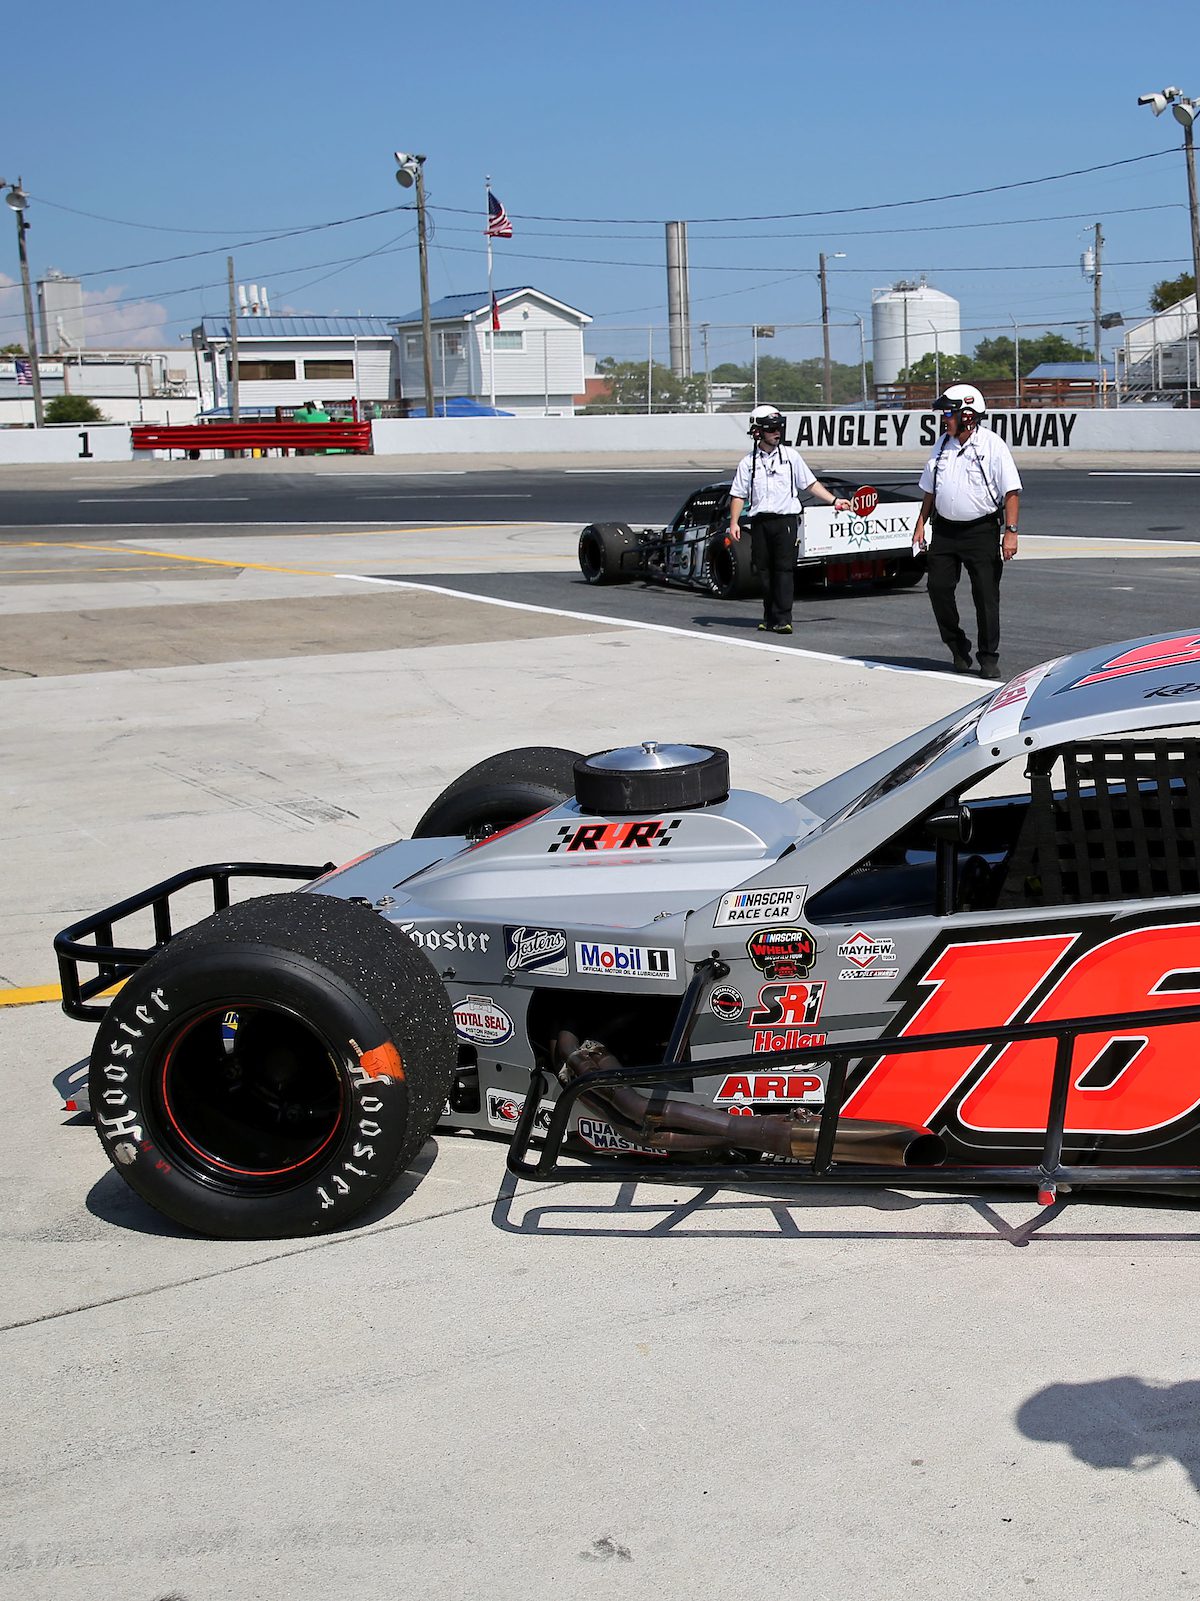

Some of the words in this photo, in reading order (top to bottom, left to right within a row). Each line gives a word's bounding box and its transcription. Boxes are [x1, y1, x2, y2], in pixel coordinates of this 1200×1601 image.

[780, 414, 909, 446] LANGLEY
[920, 413, 1076, 446] SDWAY
[78, 432, 93, 458] 1
[853, 492, 878, 511] STOP
[829, 516, 911, 539] PHOENIX
[567, 820, 664, 852] RYR
[746, 891, 794, 907] NASCAR
[728, 909, 761, 920] RACE
[764, 907, 789, 918] CAR
[507, 927, 566, 970] Jostens
[769, 932, 803, 943] NASCAR
[581, 944, 641, 970] Mobil
[839, 944, 892, 955] MAYHEW
[453, 1012, 483, 1027] TOTAL
[484, 1015, 506, 1031] SEAL
[718, 1076, 821, 1098] ARP
